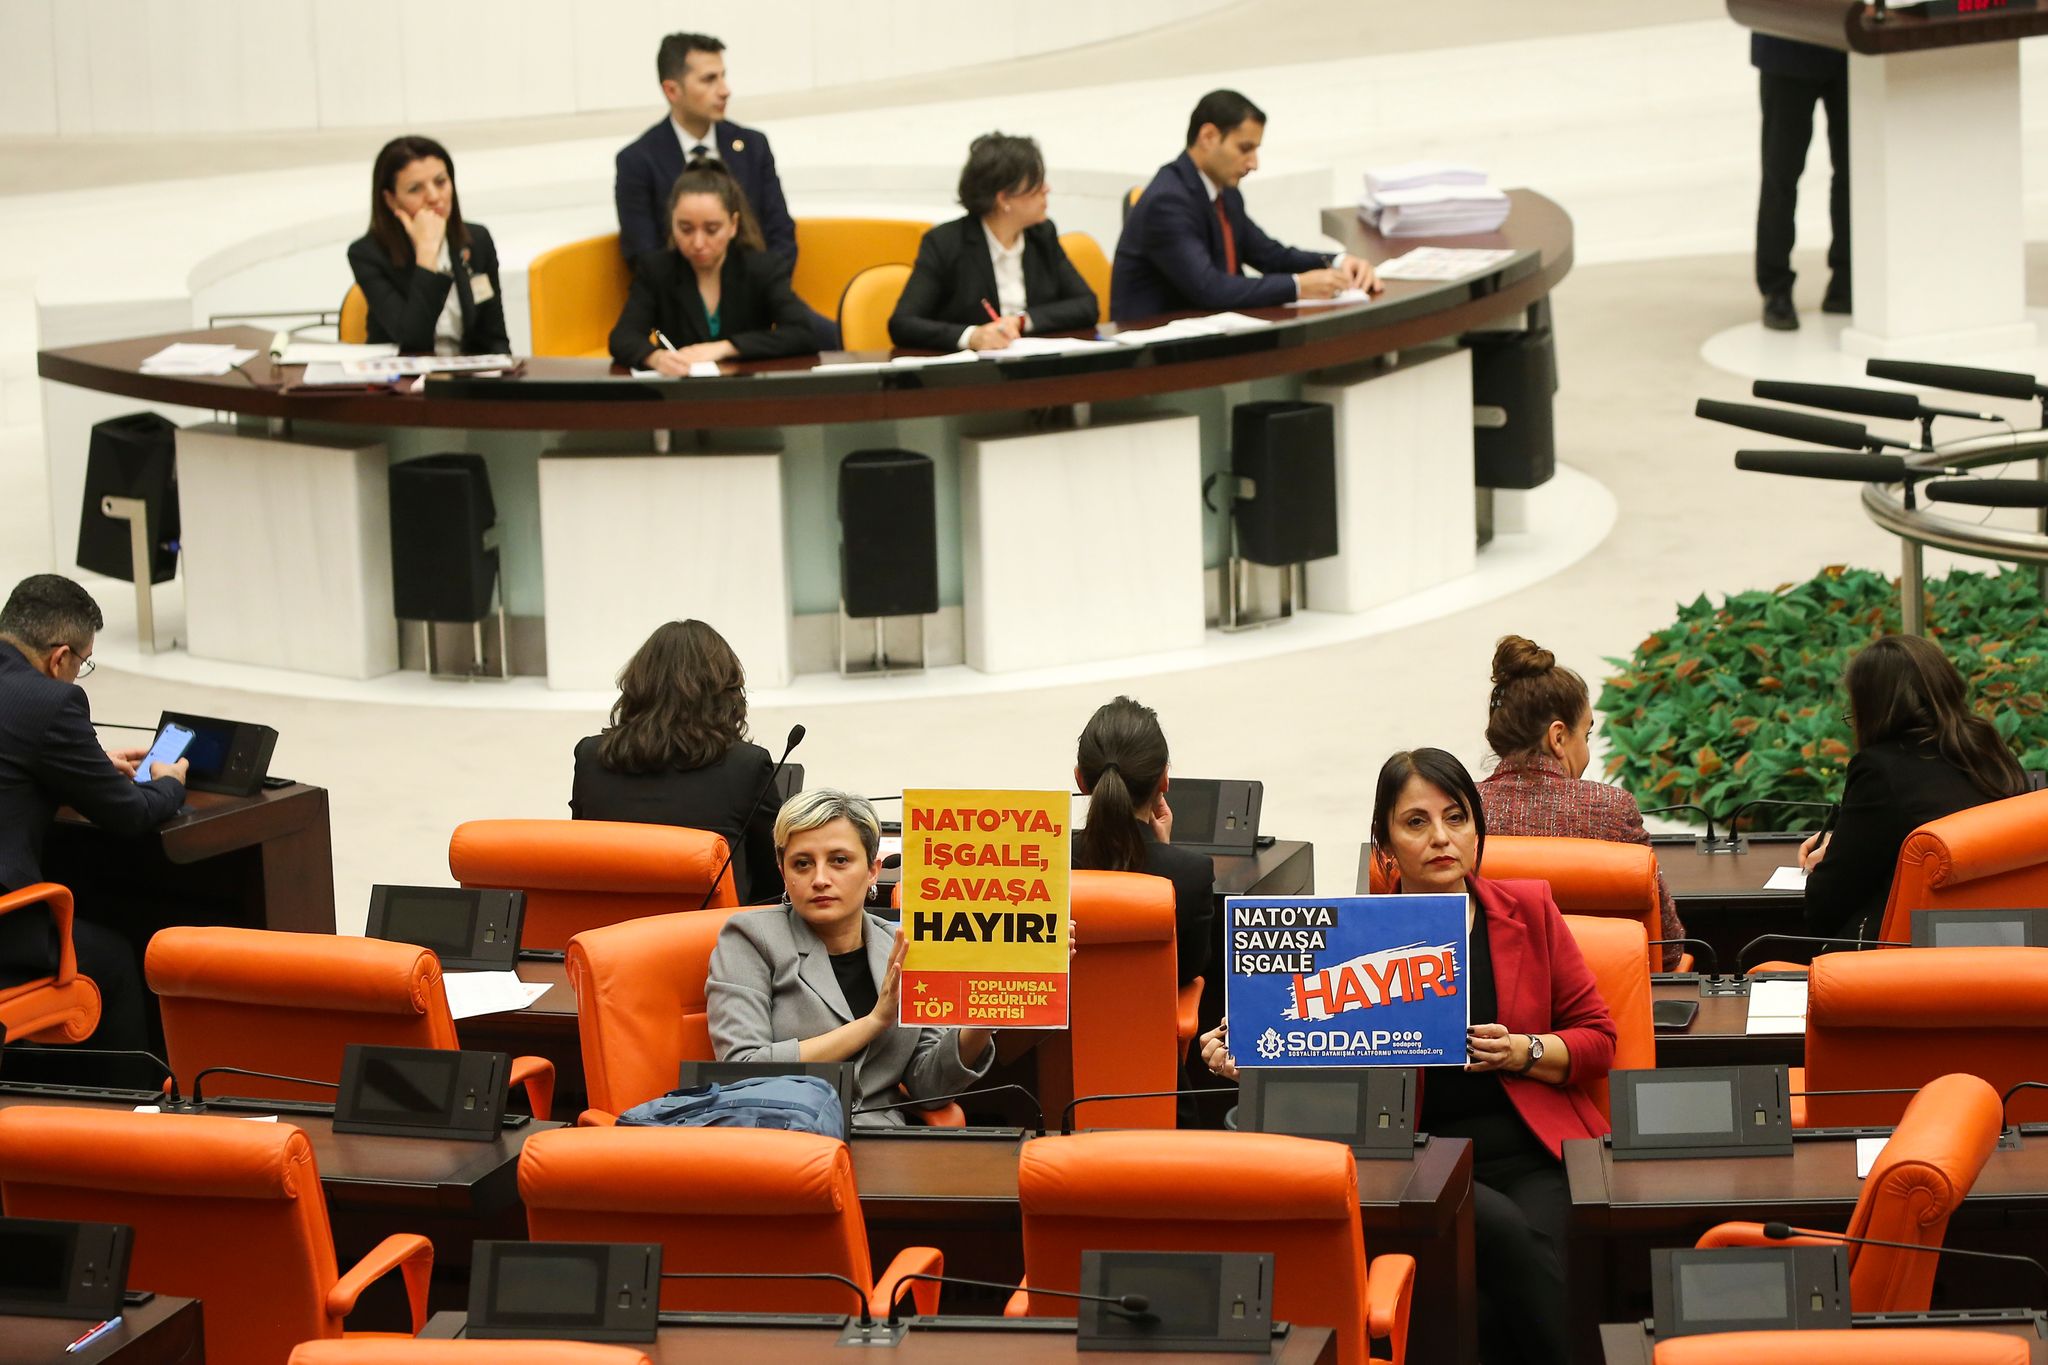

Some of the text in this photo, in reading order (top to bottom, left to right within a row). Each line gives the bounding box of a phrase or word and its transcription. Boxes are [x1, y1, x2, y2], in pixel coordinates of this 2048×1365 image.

[911, 808, 1062, 837] NATO'YA,
[924, 838, 1049, 871] İŞGALE,
[920, 878, 1051, 906] SAVAŞA
[1234, 907, 1333, 926] NATO'YA
[913, 912, 1057, 943] HAYIR!
[1234, 931, 1325, 953] SAVAŞA
[1235, 951, 1313, 977] İŞGALE
[969, 980, 1056, 992] TOPLUMSAL
[1293, 951, 1457, 1018] HAYIR!
[913, 998, 954, 1018] TÖP
[968, 992, 1047, 1006] ÖZGÜRLÜK
[968, 1006, 1024, 1019] PARTİSİ
[1287, 1031, 1391, 1050] SODAP
[1392, 1048, 1443, 1056] www.sodap2.org
